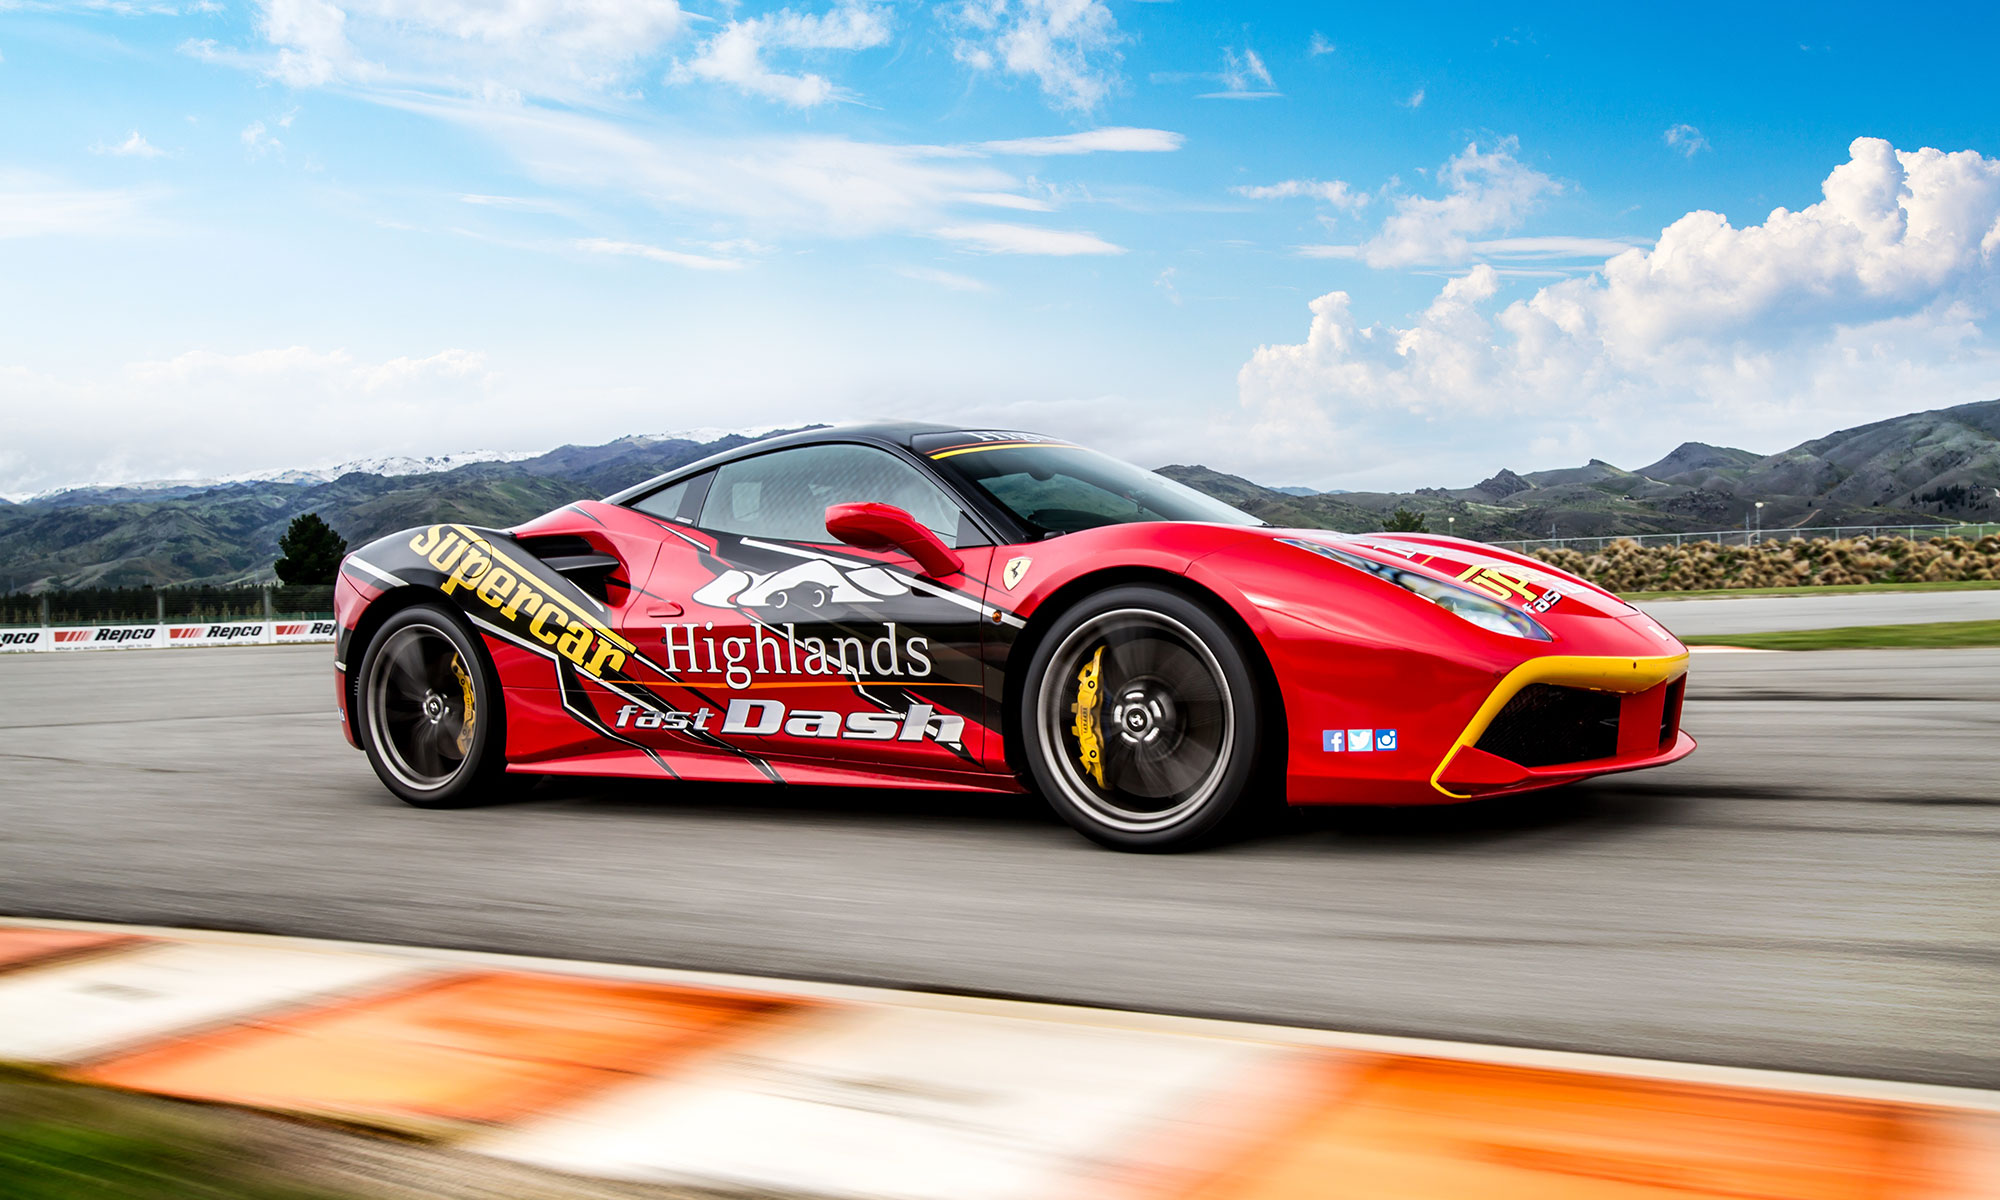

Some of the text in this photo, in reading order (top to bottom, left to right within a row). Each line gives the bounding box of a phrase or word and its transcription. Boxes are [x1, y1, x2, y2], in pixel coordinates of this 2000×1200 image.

[0, 632, 40, 648] pco
[94, 628, 156, 643] Repco
[206, 625, 263, 640] Repco
[660, 621, 932, 690] Highlands
[614, 698, 966, 742] fast Dash
